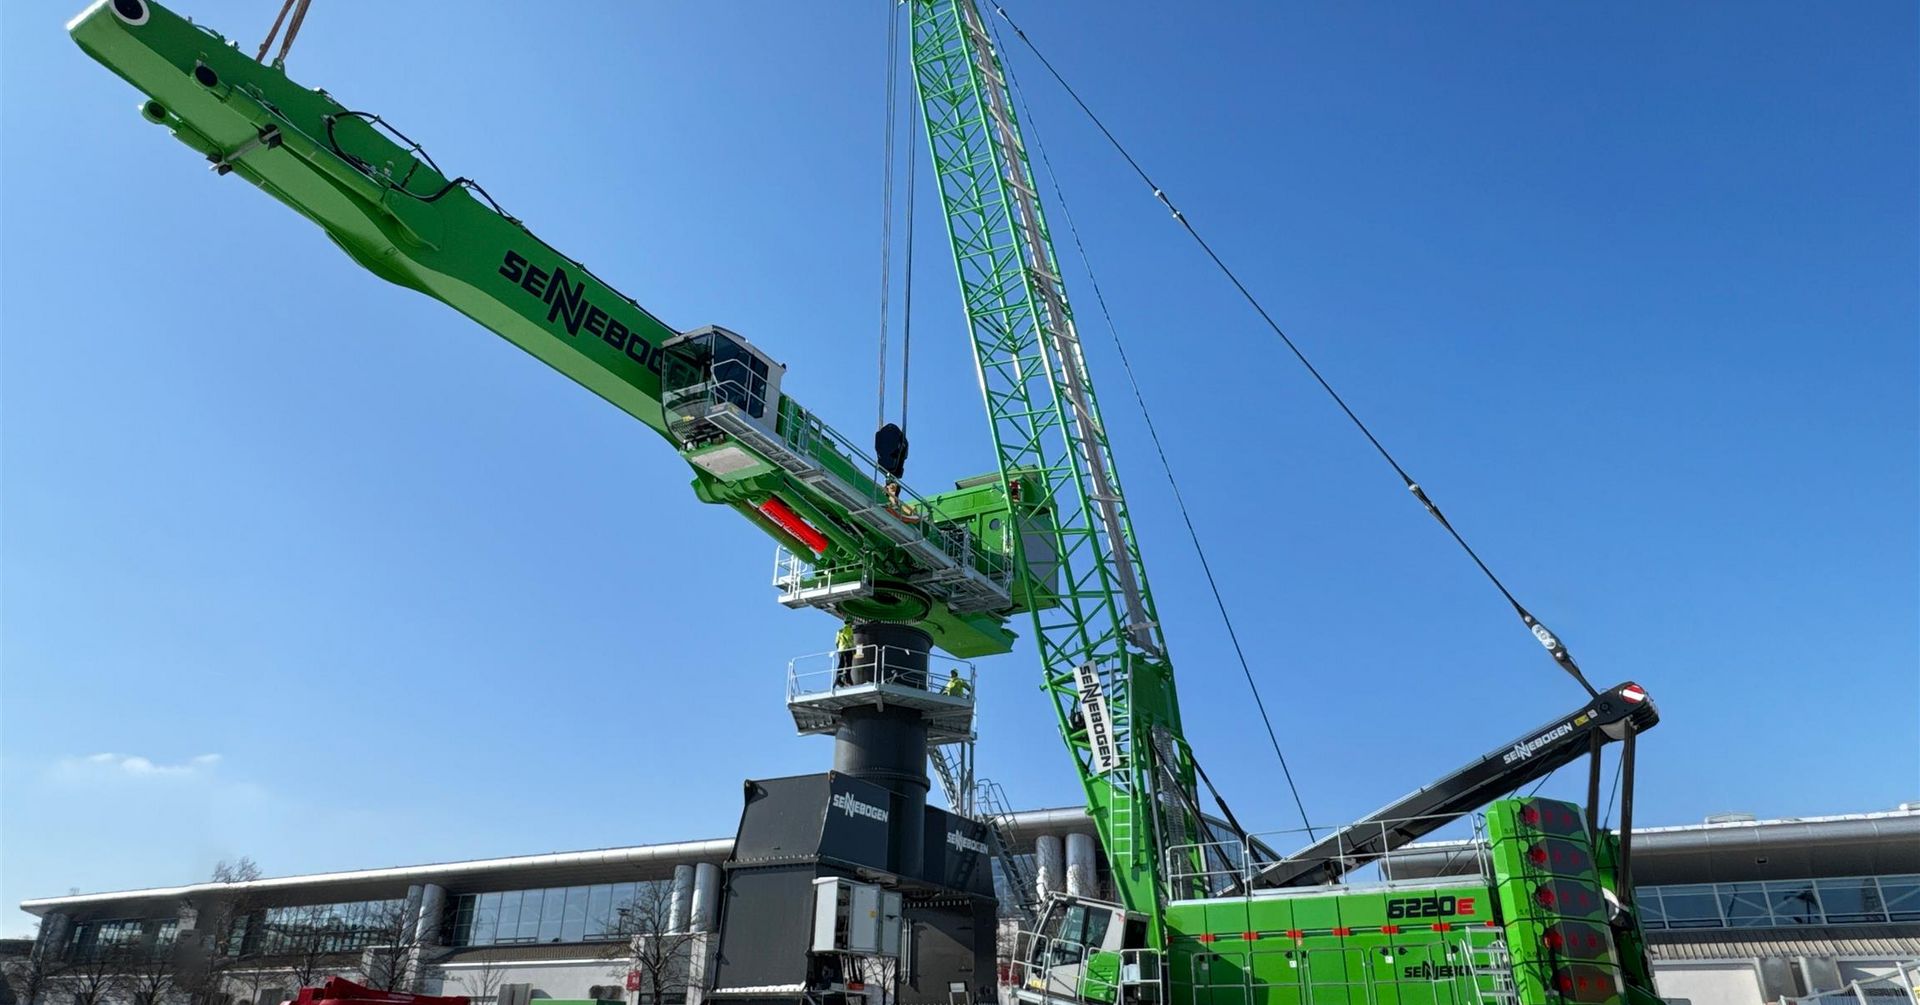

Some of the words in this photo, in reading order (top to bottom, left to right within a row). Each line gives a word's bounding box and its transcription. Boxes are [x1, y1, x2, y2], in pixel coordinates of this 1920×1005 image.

[1079, 665, 1112, 768] SENNEBOGEN
[1503, 722, 1573, 765] SENNEBOGEN
[832, 791, 889, 823] SENNEBOGEN
[1388, 896, 1475, 919] 6220E
